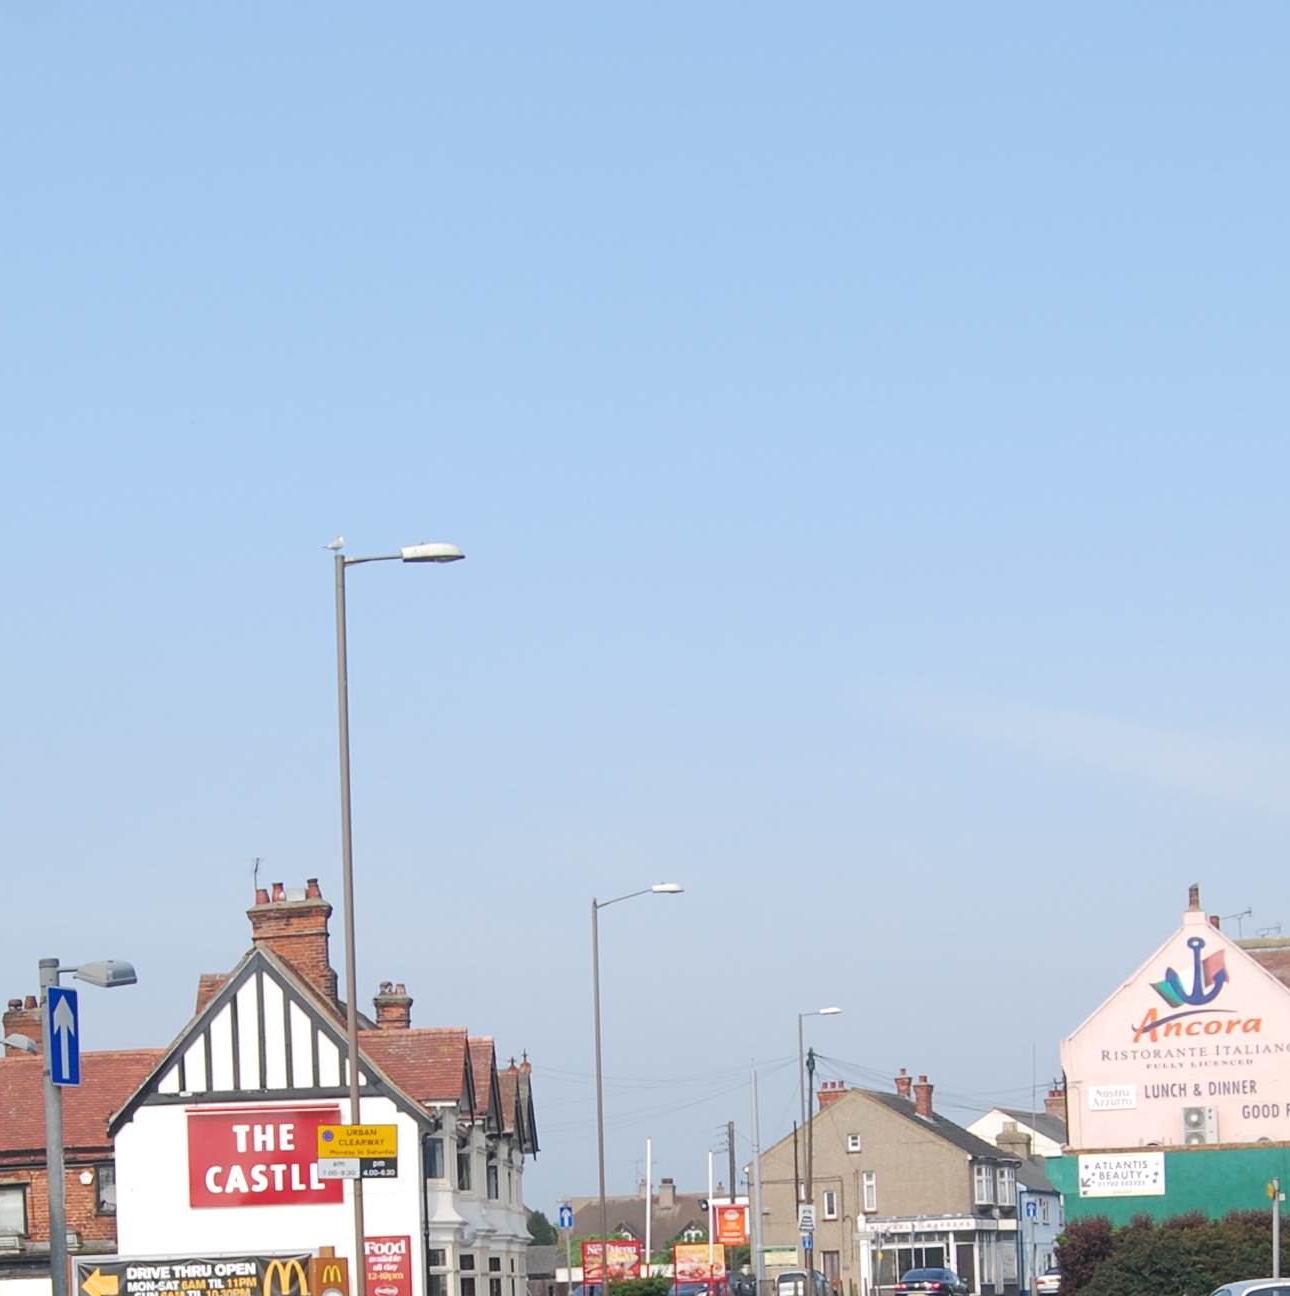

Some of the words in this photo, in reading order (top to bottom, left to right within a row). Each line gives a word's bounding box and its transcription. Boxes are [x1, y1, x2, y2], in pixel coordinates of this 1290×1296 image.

[1132, 1007, 1262, 1043] Ancora
[1146, 1062, 1185, 1070] FULLY
[1095, 1088, 1130, 1098] Nastro
[1144, 1083, 1187, 1099] LUNCH
[1193, 1084, 1202, 1097] &
[1208, 1080, 1258, 1096] DINNER
[1091, 1098, 1133, 1108] Azzurro
[1242, 1103, 1280, 1119] GOOD
[232, 1123, 295, 1153] THE
[372, 1160, 385, 1168] pm
[1094, 1160, 1148, 1170] ATLANTIS
[1099, 1171, 1143, 1180] BEAUTY
[926, 1221, 971, 1230] BARBERS
[364, 1239, 406, 1255] Food
[368, 1255, 402, 1263] available
[126, 1266, 170, 1280] DRIVE
[172, 1264, 212, 1278] THRU
[214, 1262, 257, 1276] OPEN
[372, 1263, 383, 1271] all
[383, 1263, 399, 1272] day
[127, 1280, 180, 1292] MON-SAT
[181, 1279, 206, 1290] 6AM
[208, 1278, 225, 1289] TIL
[226, 1277, 258, 1287] 11PM
